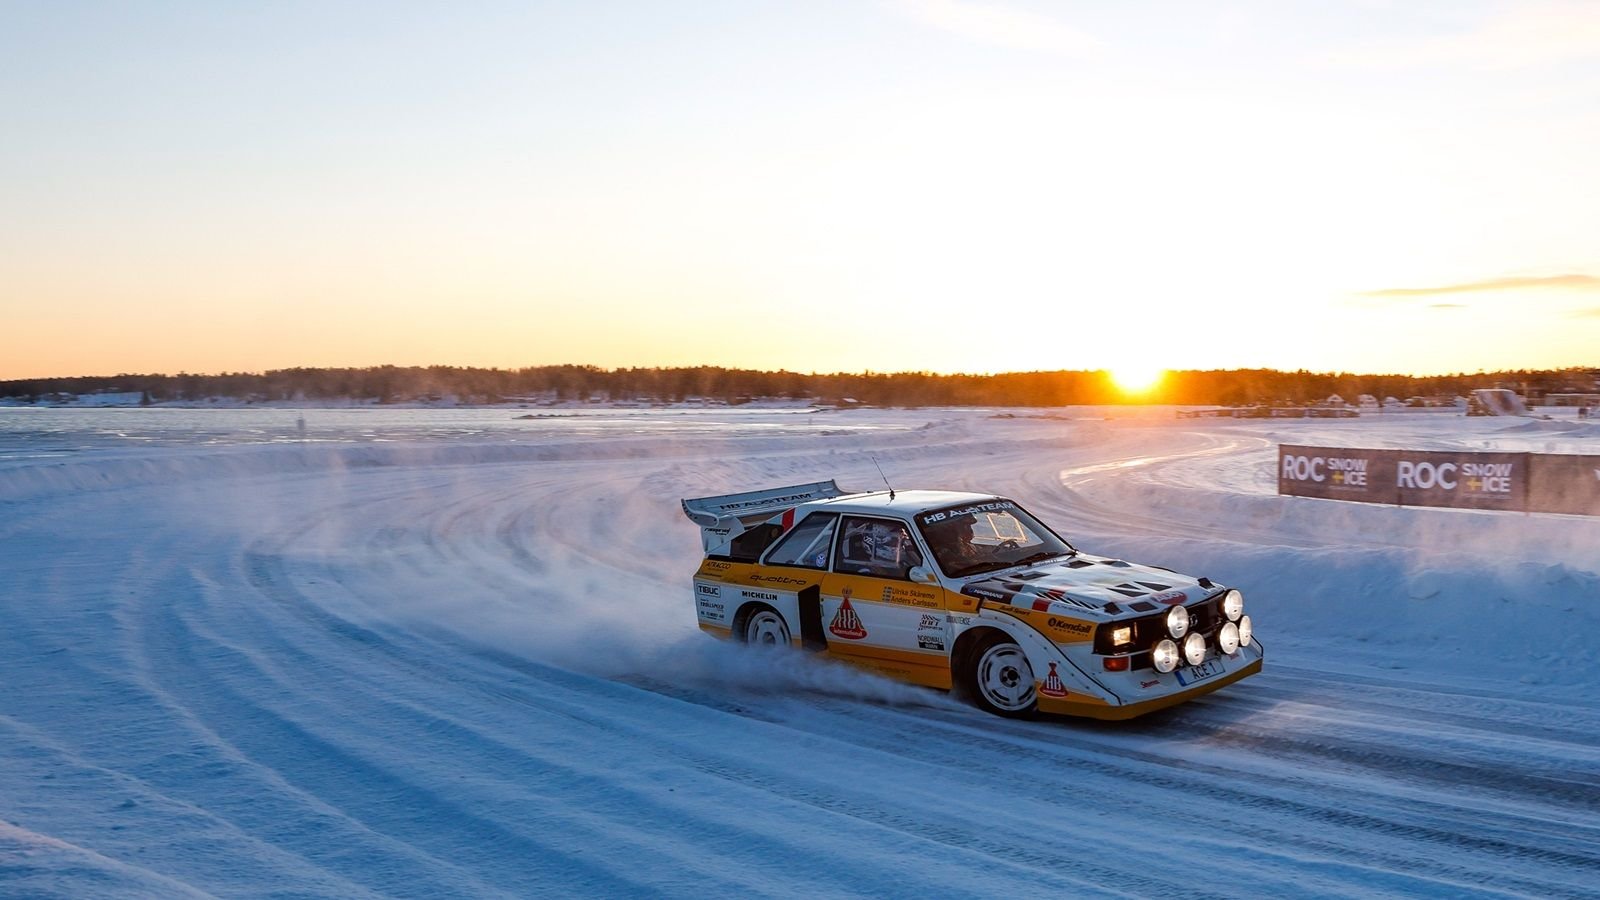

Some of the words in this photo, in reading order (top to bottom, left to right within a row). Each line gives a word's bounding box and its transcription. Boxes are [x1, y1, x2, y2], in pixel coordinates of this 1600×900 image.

[1283, 454, 1326, 482] ROC
[1327, 458, 1368, 472] SNOW
[1461, 463, 1513, 477] SNOW
[1397, 460, 1458, 490] ROC
[923, 512, 947, 525] HB
[979, 502, 1015, 512] TEAM
[750, 575, 807, 585] quattro
[741, 590, 778, 601] MICHELIN
[890, 596, 911, 605] Anders
[912, 598, 938, 607] Carlsson
[1055, 619, 1093, 634] Kendall
[1191, 665, 1210, 680] ACE
[1046, 675, 1062, 691] HB
